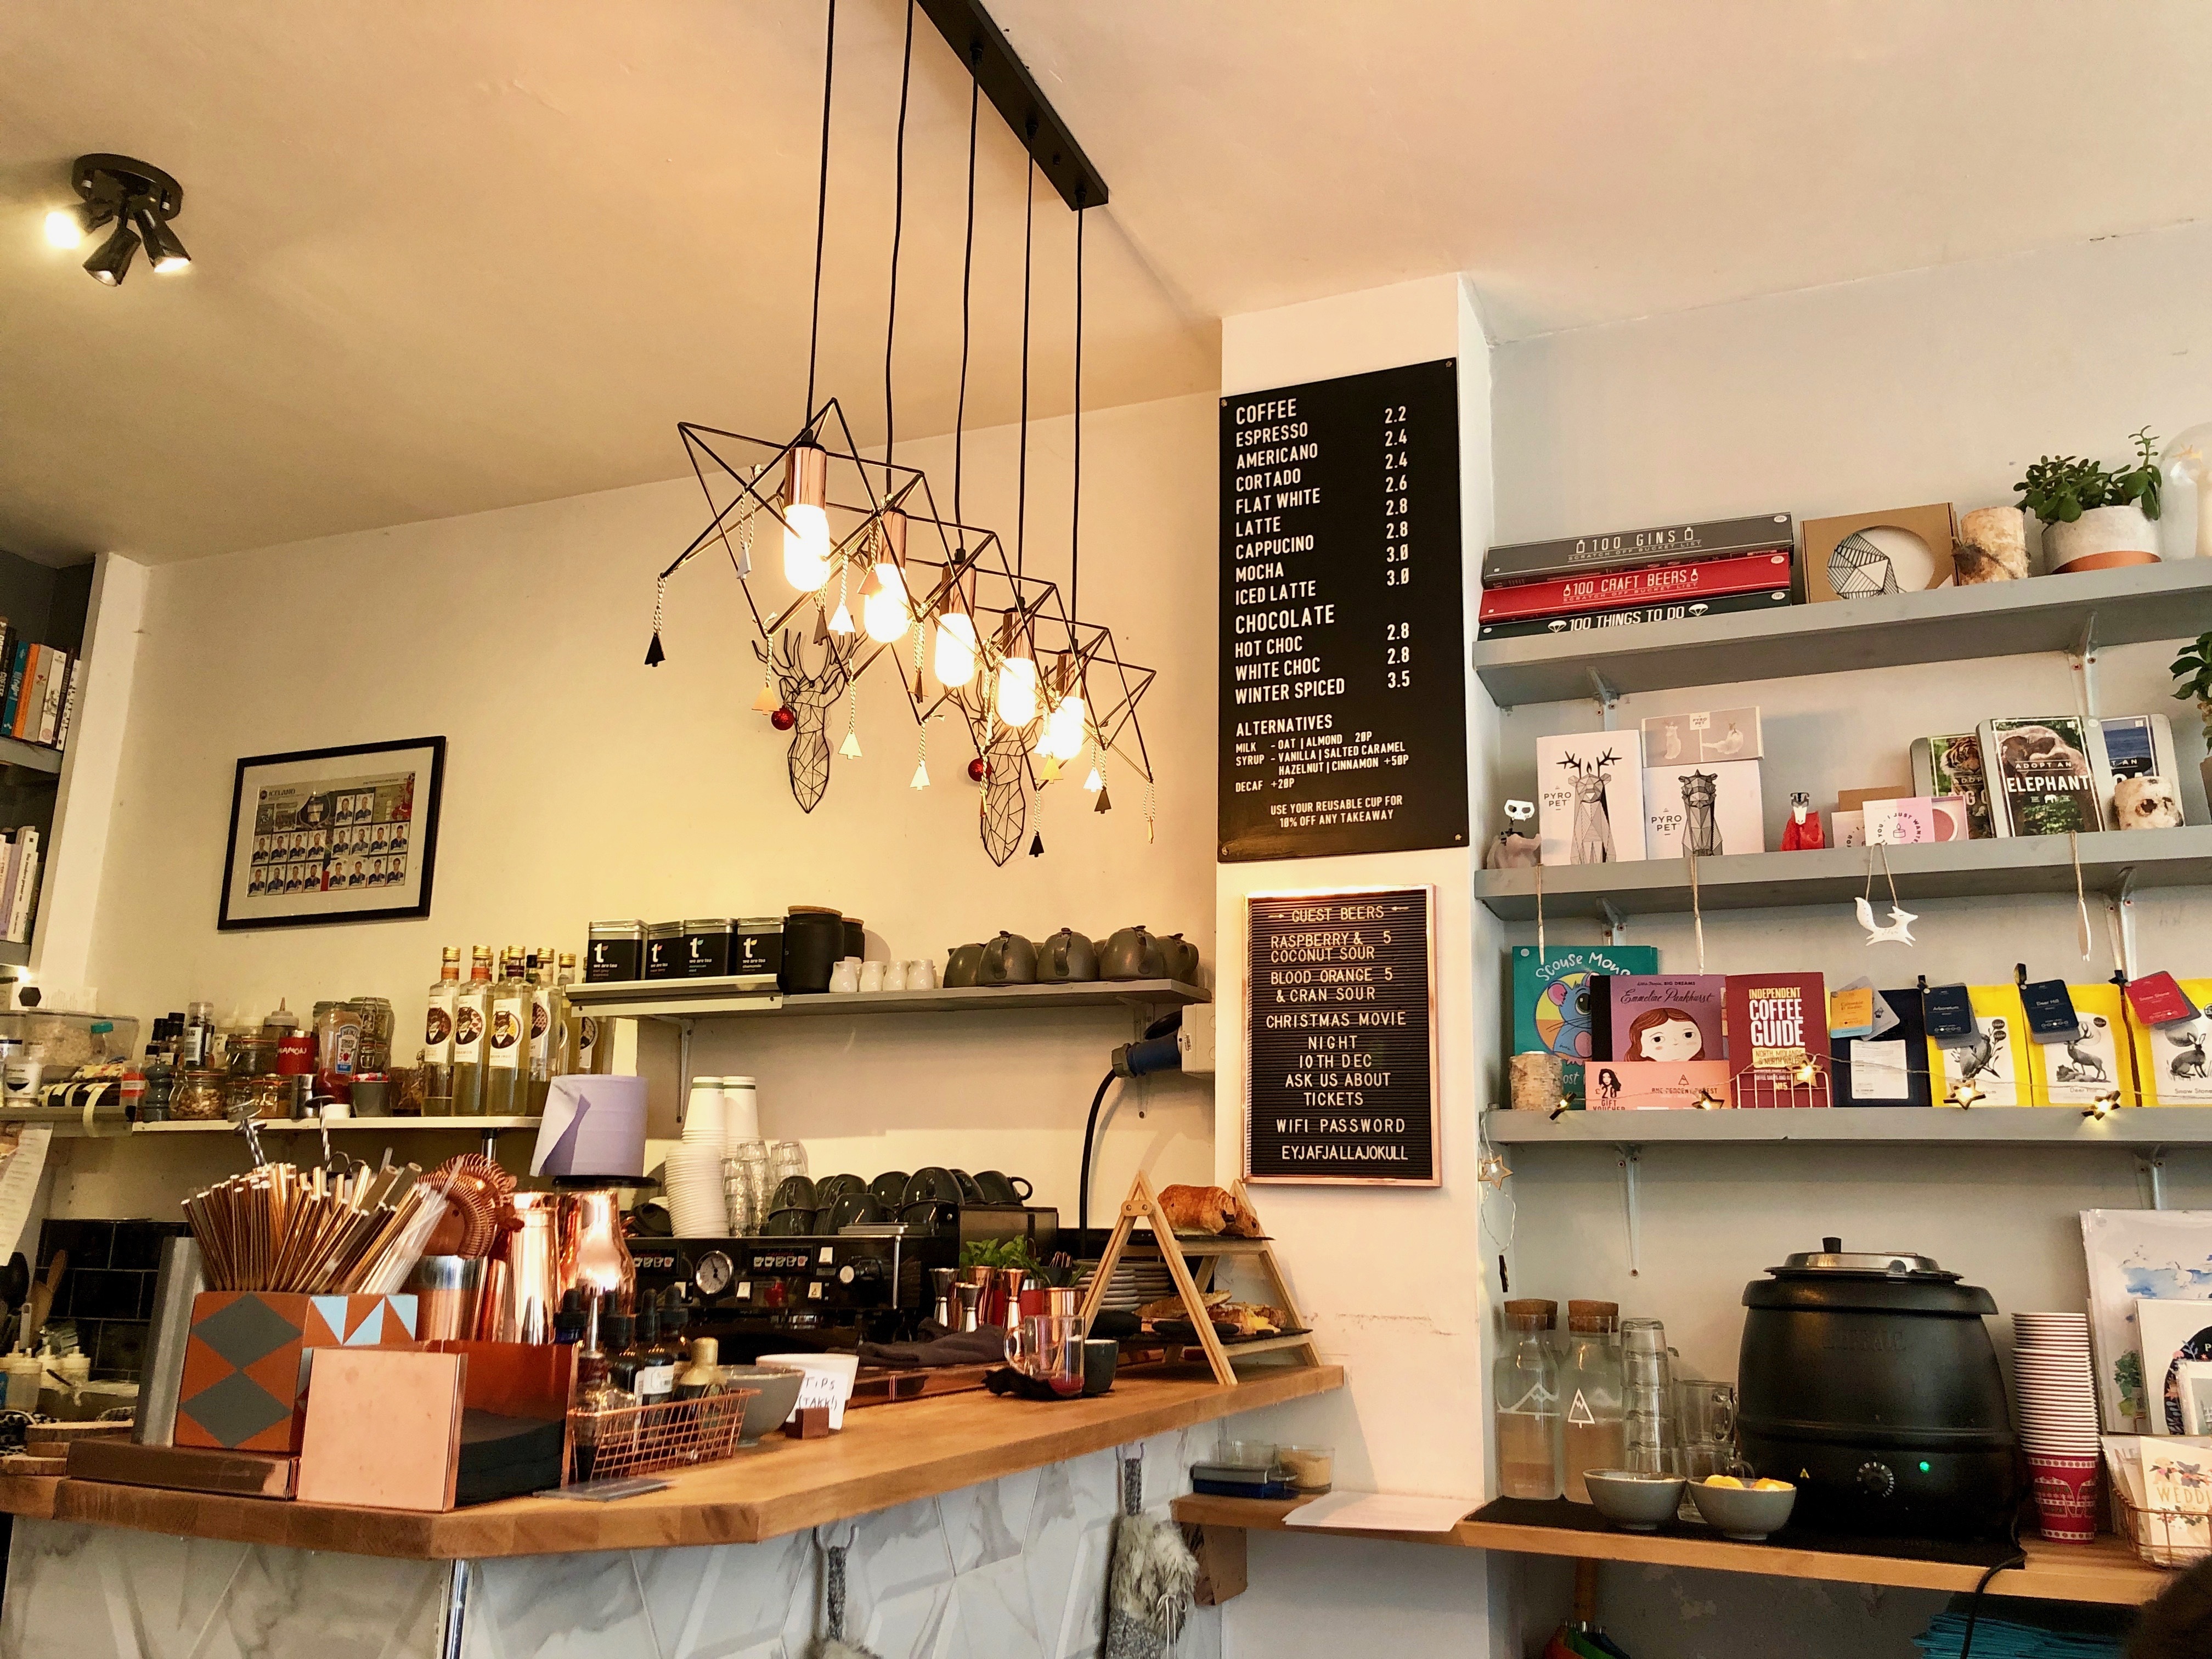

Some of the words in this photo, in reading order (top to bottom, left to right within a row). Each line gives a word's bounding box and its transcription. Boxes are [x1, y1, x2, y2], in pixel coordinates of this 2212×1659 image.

[1236, 398, 1296, 425] COFFEE
[1236, 422, 1308, 447] ESPRESSO
[1385, 406, 1406, 424] 2.2
[1237, 443, 1318, 470] AMERICANO
[1385, 429, 1407, 447] 2.4
[1236, 469, 1301, 492] CORTADO
[1385, 452, 1408, 470] 2.4
[1236, 495, 1271, 514] FLAT
[1277, 488, 1320, 509] WHITE
[1386, 475, 1407, 492] 2.6
[1236, 517, 1280, 537] LATTE
[1386, 498, 1408, 516] 2.8
[1236, 535, 1314, 560] CAPPUCINO
[1386, 522, 1408, 539] 2.8
[1593, 536, 1621, 552] 100
[1636, 530, 1676, 546] GINS
[1638, 544, 1678, 554] BUCKET
[1236, 562, 1284, 582] MOCHA
[1386, 544, 1408, 562] 3.0
[1236, 588, 1265, 605] ICED
[1271, 580, 1316, 601] LATTE
[1387, 568, 1409, 585] 3.0
[1573, 580, 1594, 596] 100
[1601, 575, 1640, 592] CRAFT
[1647, 569, 1687, 588] BEERS
[1235, 604, 1335, 634] CHOCOLATE
[1569, 617, 1591, 631] 100
[1596, 611, 1641, 629] THINGS
[1646, 608, 1662, 622] TO
[1667, 606, 1685, 620] DO
[1235, 641, 1262, 658] HOT
[1267, 636, 1302, 654] CHOC
[1387, 623, 1409, 640] 2.8
[1235, 662, 1279, 681] WHITE
[1284, 657, 1321, 676] CHOC
[1387, 646, 1409, 664] 2.8
[1235, 685, 1289, 704] WINTER
[1295, 678, 1345, 698] SPICED
[1388, 671, 1410, 689] 3.5
[1236, 714, 1333, 736] ALTERNATIVES
[1236, 742, 1256, 753] MILK
[1278, 738, 1296, 750] OAT
[1306, 735, 1342, 747] ALMOND
[1355, 732, 1372, 742] 20P
[1236, 754, 1265, 766] SYRUP
[1278, 751, 1316, 763] VANILLA
[1324, 746, 1359, 759] SALTED
[1362, 742, 1405, 755] CARAMEL
[1279, 763, 1323, 775] HAZELNUT
[1332, 757, 1379, 771] CINNAMON
[1235, 781, 1263, 792] DECAF
[1953, 776, 1982, 784] ADOP
[2007, 775, 2089, 792] ELEPHANT
[1271, 804, 1287, 815] USE
[1290, 802, 1313, 814] YOUR
[1317, 798, 1362, 812] REUSABLE
[1365, 797, 1382, 808] CUP
[1385, 795, 1403, 805] FOR
[1544, 791, 1571, 800] PYRO
[1280, 817, 1297, 828] 10%
[1300, 816, 1316, 826] OFF
[1319, 814, 1337, 825] ANY
[1341, 809, 1394, 823] TAKEAWAY
[1651, 815, 1681, 824] PYRO
[1913, 819, 1921, 844] WANTE
[1293, 909, 1332, 923] GUEST
[1340, 906, 1384, 920] BEERS
[1271, 933, 1349, 949] RASPBERRY
[1354, 932, 1363, 944] &
[1383, 931, 1391, 944] 5
[1271, 948, 1333, 963] COCONUT
[1340, 946, 1375, 960] SOUR
[1271, 970, 1311, 985] BLOOD
[1321, 968, 1373, 982] ORANGE
[1385, 968, 1392, 980] 5
[1536, 953, 1583, 981] Scouse
[1276, 990, 1285, 1002] &
[1290, 989, 1327, 1002] CRAN
[1336, 988, 1375, 1001] SOUR
[1621, 988, 1662, 1004] Emmeline
[1663, 987, 1715, 1003] Pankhurst
[1748, 988, 1801, 999] INDEPENDENT
[1749, 998, 1803, 1020] COFFEE
[1266, 1013, 1350, 1029] CHRISTMAS
[1359, 1012, 1406, 1026] MOVIE
[1308, 1036, 1357, 1050] NIGHT
[1751, 1020, 1805, 1046] GUIDE
[1342, 1054, 1372, 1068] DEC
[1285, 1074, 1313, 1088] ASK
[1320, 1074, 1338, 1087] US
[1345, 1073, 1391, 1087] ABOUT
[1304, 1092, 1363, 1106] TICKETS
[1277, 1119, 1308, 1133] WIFI
[1321, 1119, 1405, 1133] PASSWORD
[1282, 1146, 1408, 1160] EYJAFJALLAJOKULL
